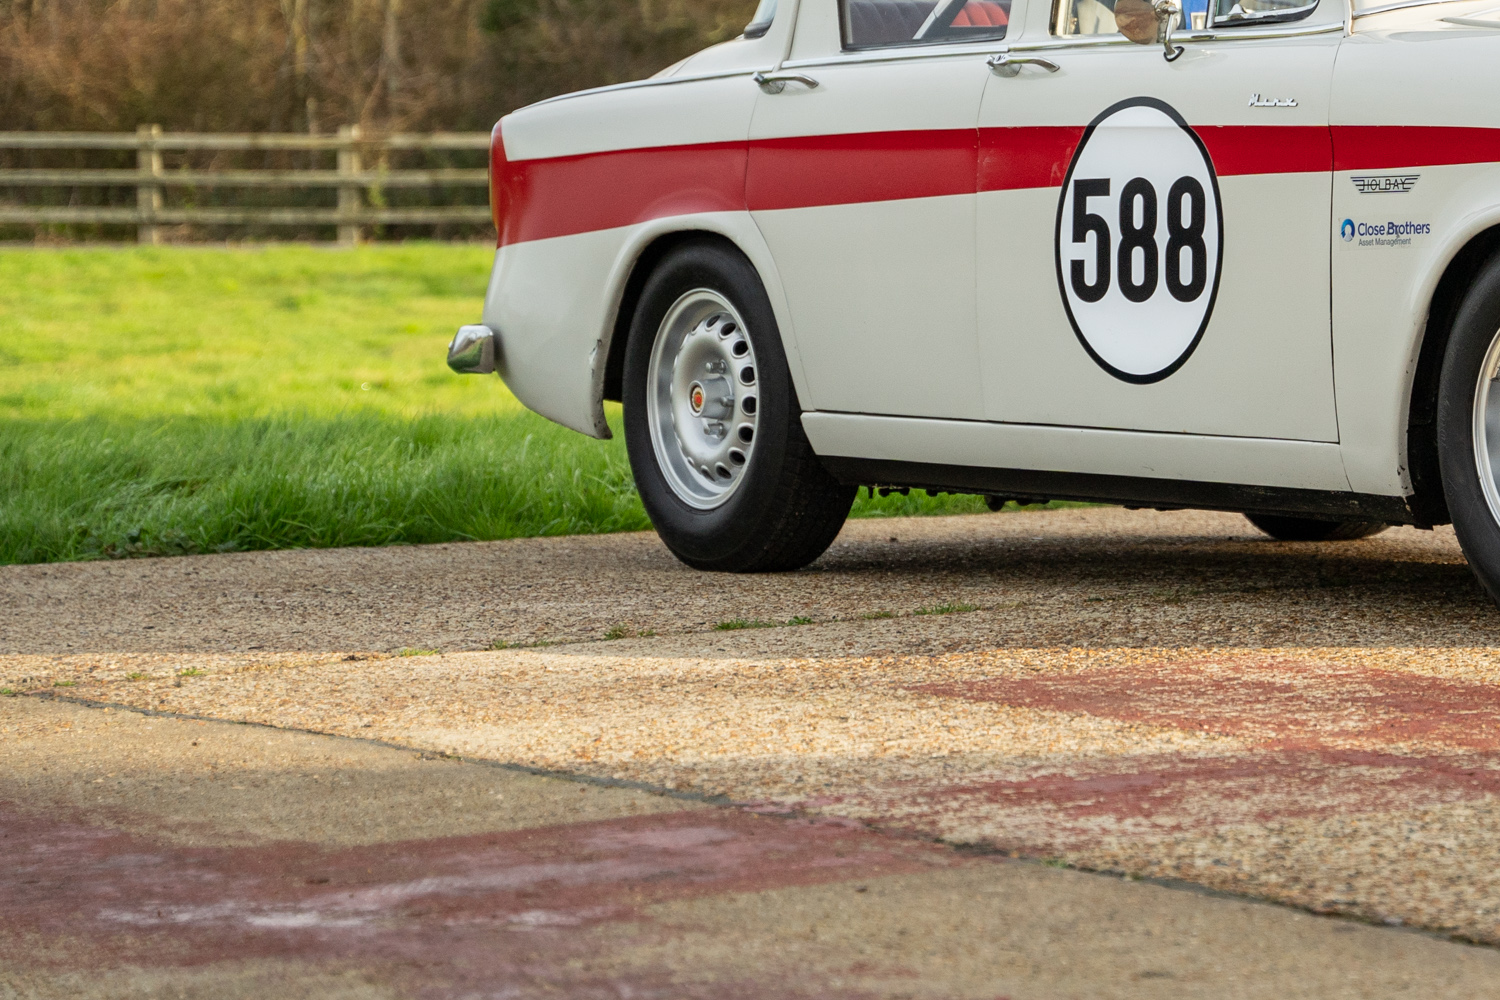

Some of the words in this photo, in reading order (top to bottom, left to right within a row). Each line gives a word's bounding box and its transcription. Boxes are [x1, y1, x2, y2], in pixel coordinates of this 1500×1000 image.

[1353, 177, 1416, 192] HOLBAY
[1358, 222, 1385, 236] Close
[1387, 221, 1431, 235] Brothers
[1070, 176, 1207, 303] 588
[1375, 238, 1411, 247] Management
